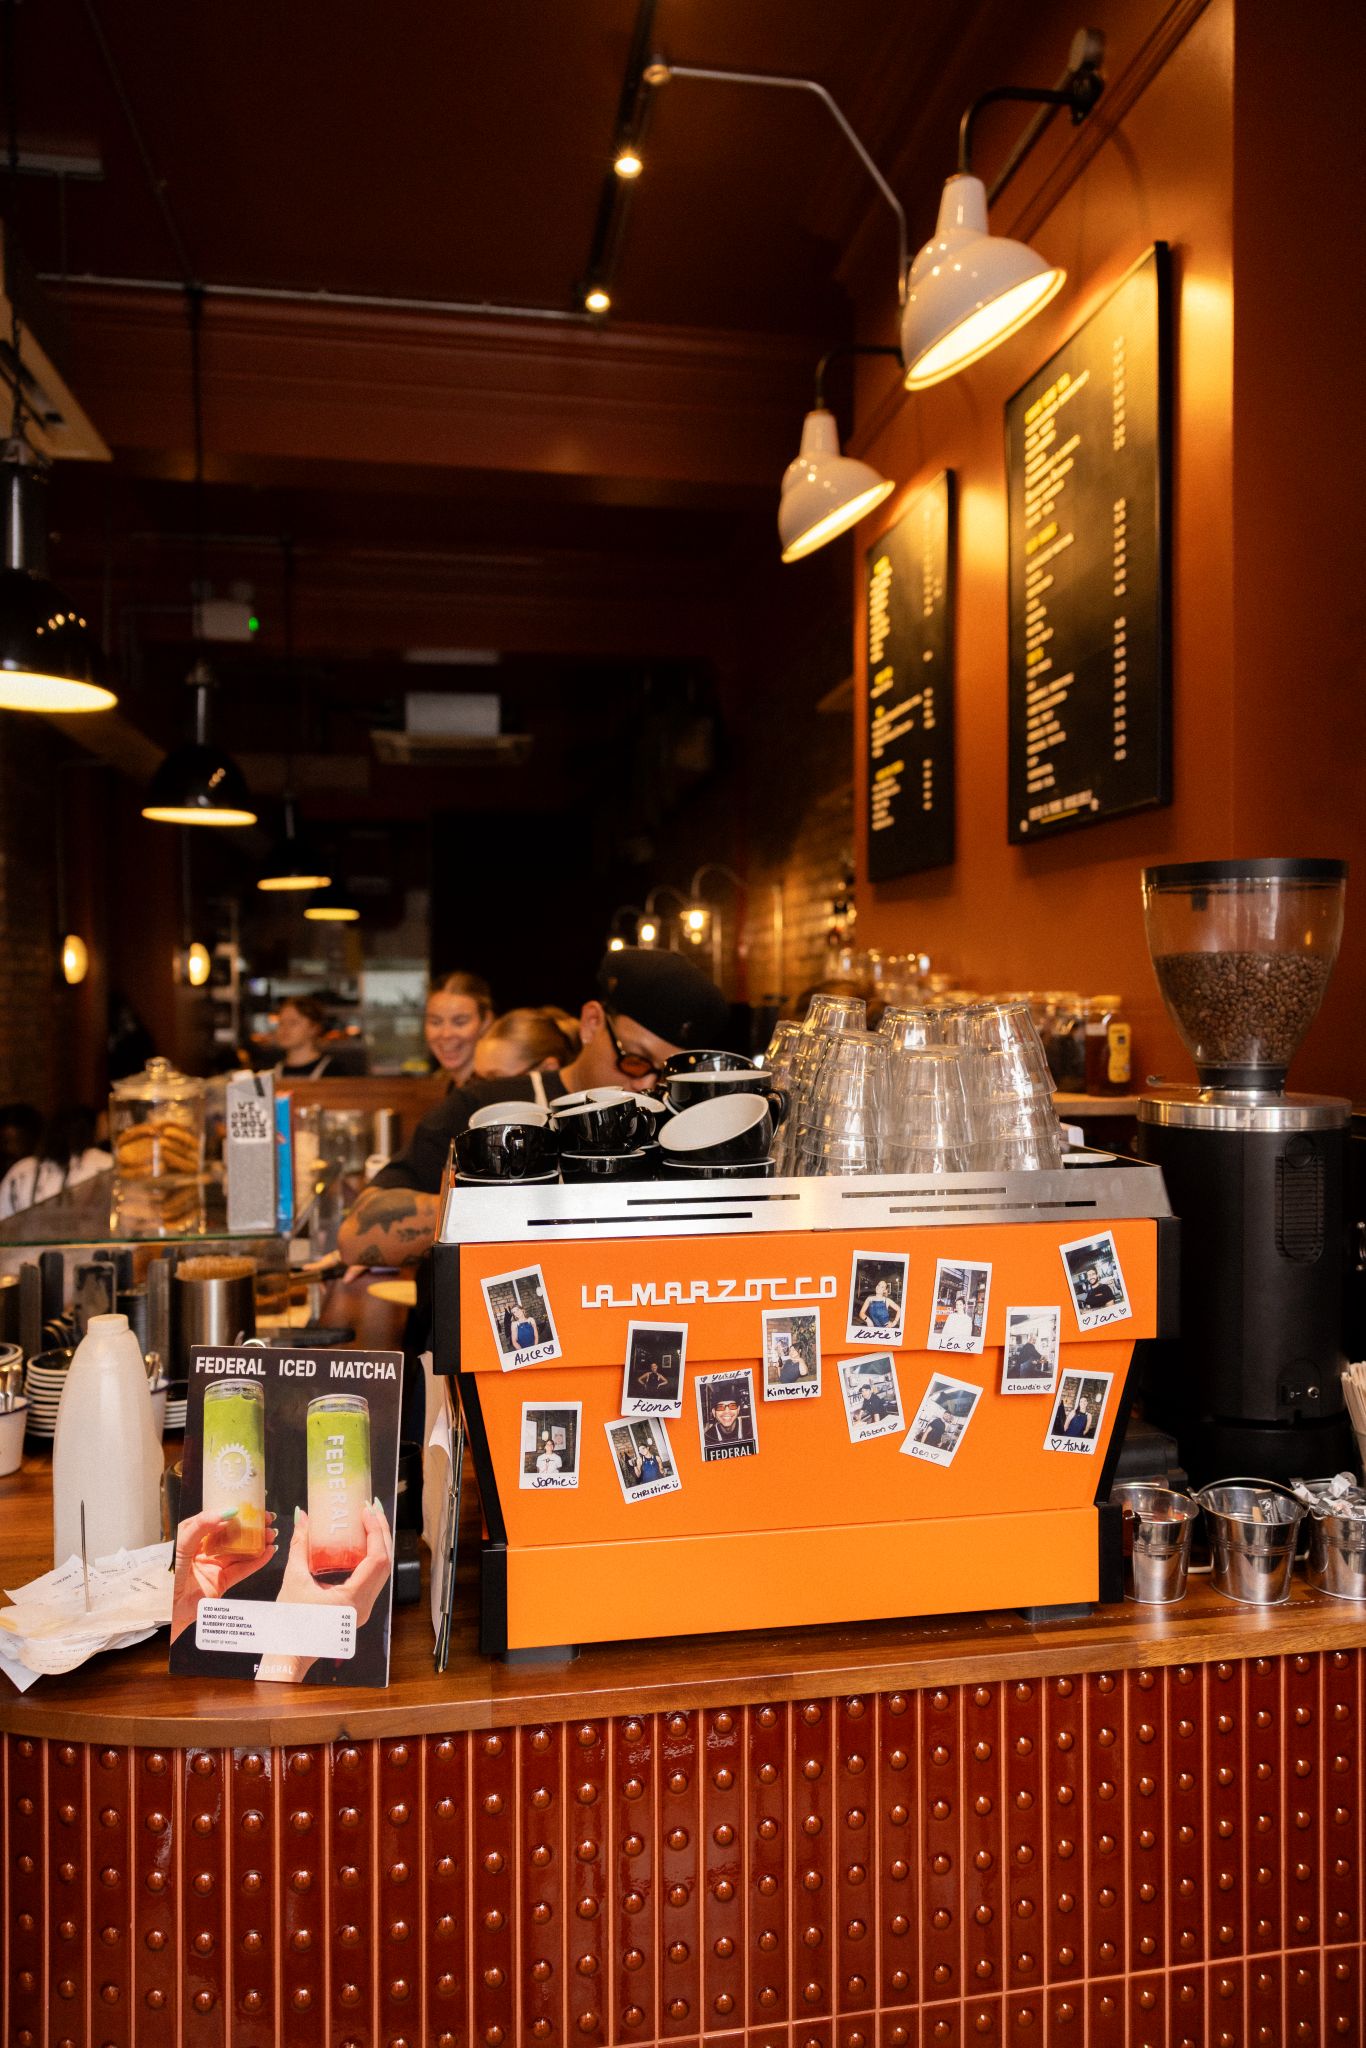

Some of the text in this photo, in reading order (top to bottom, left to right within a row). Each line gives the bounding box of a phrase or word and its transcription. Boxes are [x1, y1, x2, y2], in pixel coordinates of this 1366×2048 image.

[233, 1129, 266, 1138] OATS
[581, 1284, 620, 1308] LA
[854, 1329, 892, 1339] Katie
[938, 1337, 961, 1350] Léa
[195, 1356, 397, 1380] FEDERAL ICED MATCHA
[767, 1385, 810, 1397] Kimberly
[632, 1399, 672, 1412] Fiona
[710, 1445, 752, 1461] FEDERAL
[325, 1434, 351, 1535] FEDERAL
[532, 1476, 568, 1488] Sophie
[253, 1663, 293, 1675] FEDERAL
